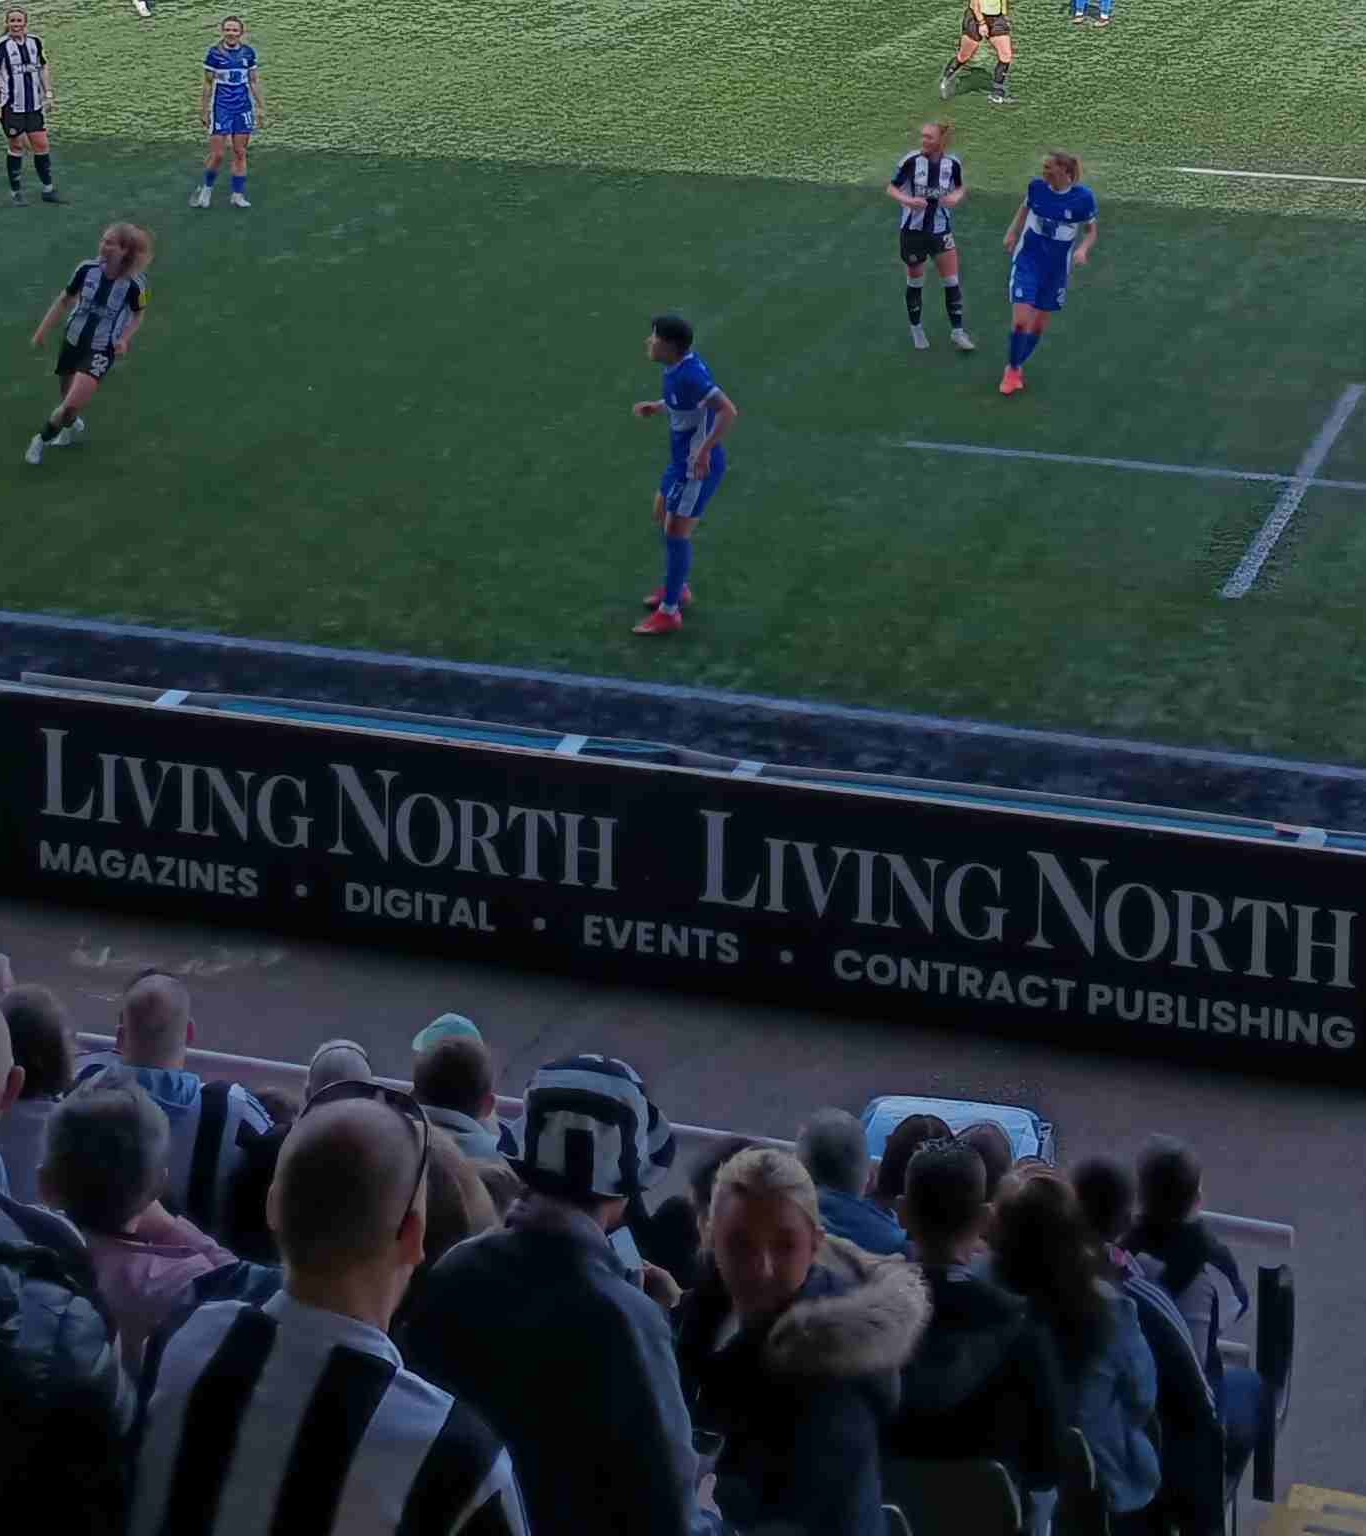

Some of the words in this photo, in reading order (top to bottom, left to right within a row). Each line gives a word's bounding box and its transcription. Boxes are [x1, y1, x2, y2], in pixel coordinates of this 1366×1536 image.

[39, 727, 315, 848] LIVING
[325, 763, 618, 892] NORTH
[698, 808, 1010, 942] LIVING
[1023, 850, 1358, 990] NORTH
[39, 840, 260, 898] MAGAZINES
[344, 881, 496, 934] DIGITAL
[582, 914, 740, 965] EVENTS
[833, 948, 1077, 1013] CONTRACT
[1087, 982, 1357, 1050] PUBLISHING
